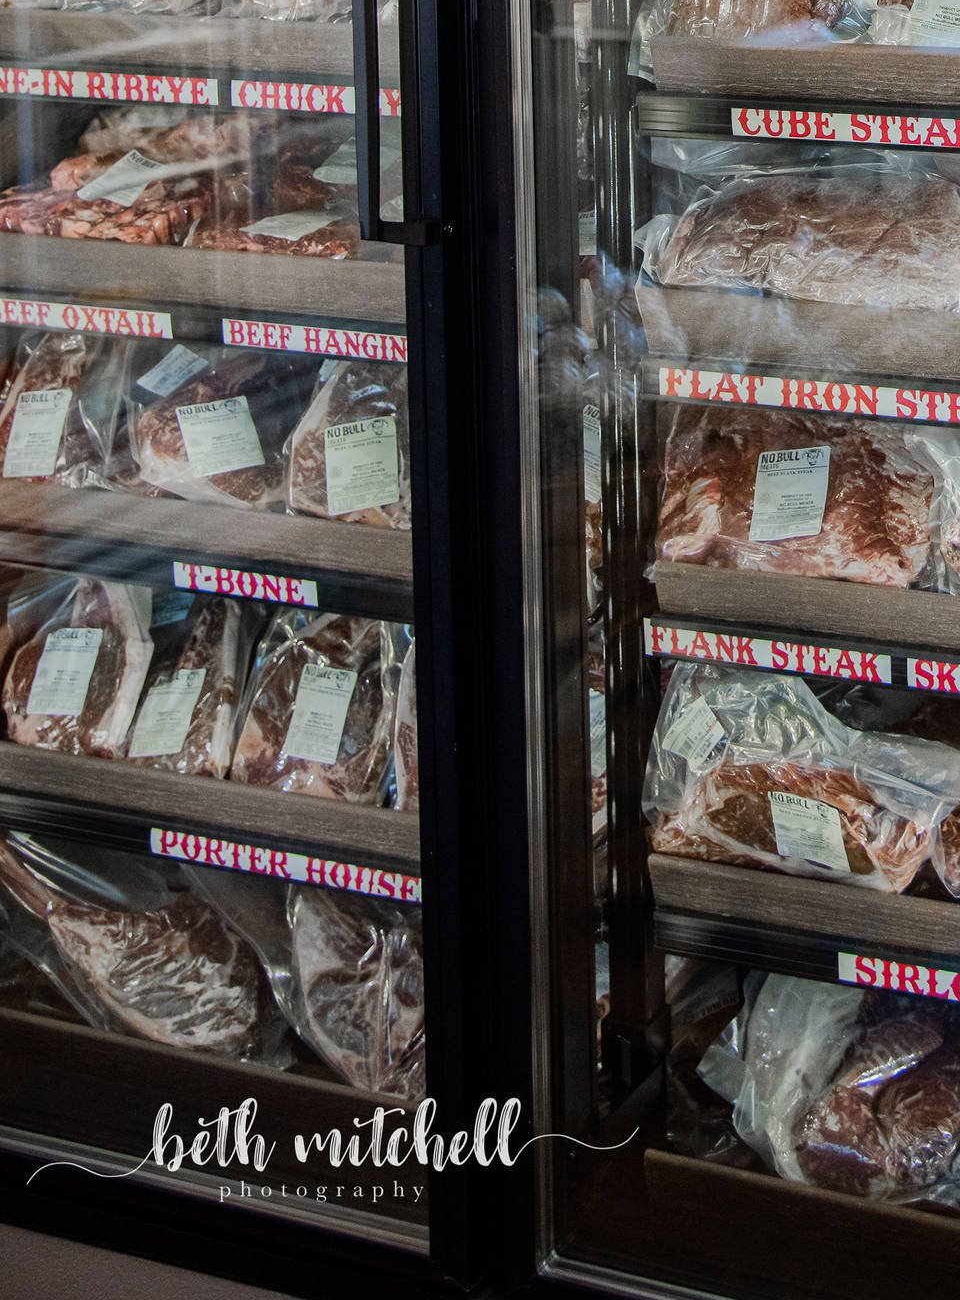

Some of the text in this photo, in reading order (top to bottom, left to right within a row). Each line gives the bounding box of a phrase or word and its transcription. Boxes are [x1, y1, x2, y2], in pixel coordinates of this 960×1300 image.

[86, 72, 211, 105] RIBEYE
[239, 81, 346, 114] CHUCK
[738, 109, 837, 140] CUBE
[0, 300, 164, 339] EEF OXTAIL
[229, 319, 408, 362] BEEF HANGIN
[664, 368, 765, 404] FLAT
[781, 378, 879, 416] IRON
[327, 423, 366, 438] NO BULL
[761, 451, 801, 464] NO BULL
[182, 563, 305, 605] T-BONE
[651, 626, 882, 683] FLANK STEAK
[160, 830, 421, 903] PORTER HOUSE
